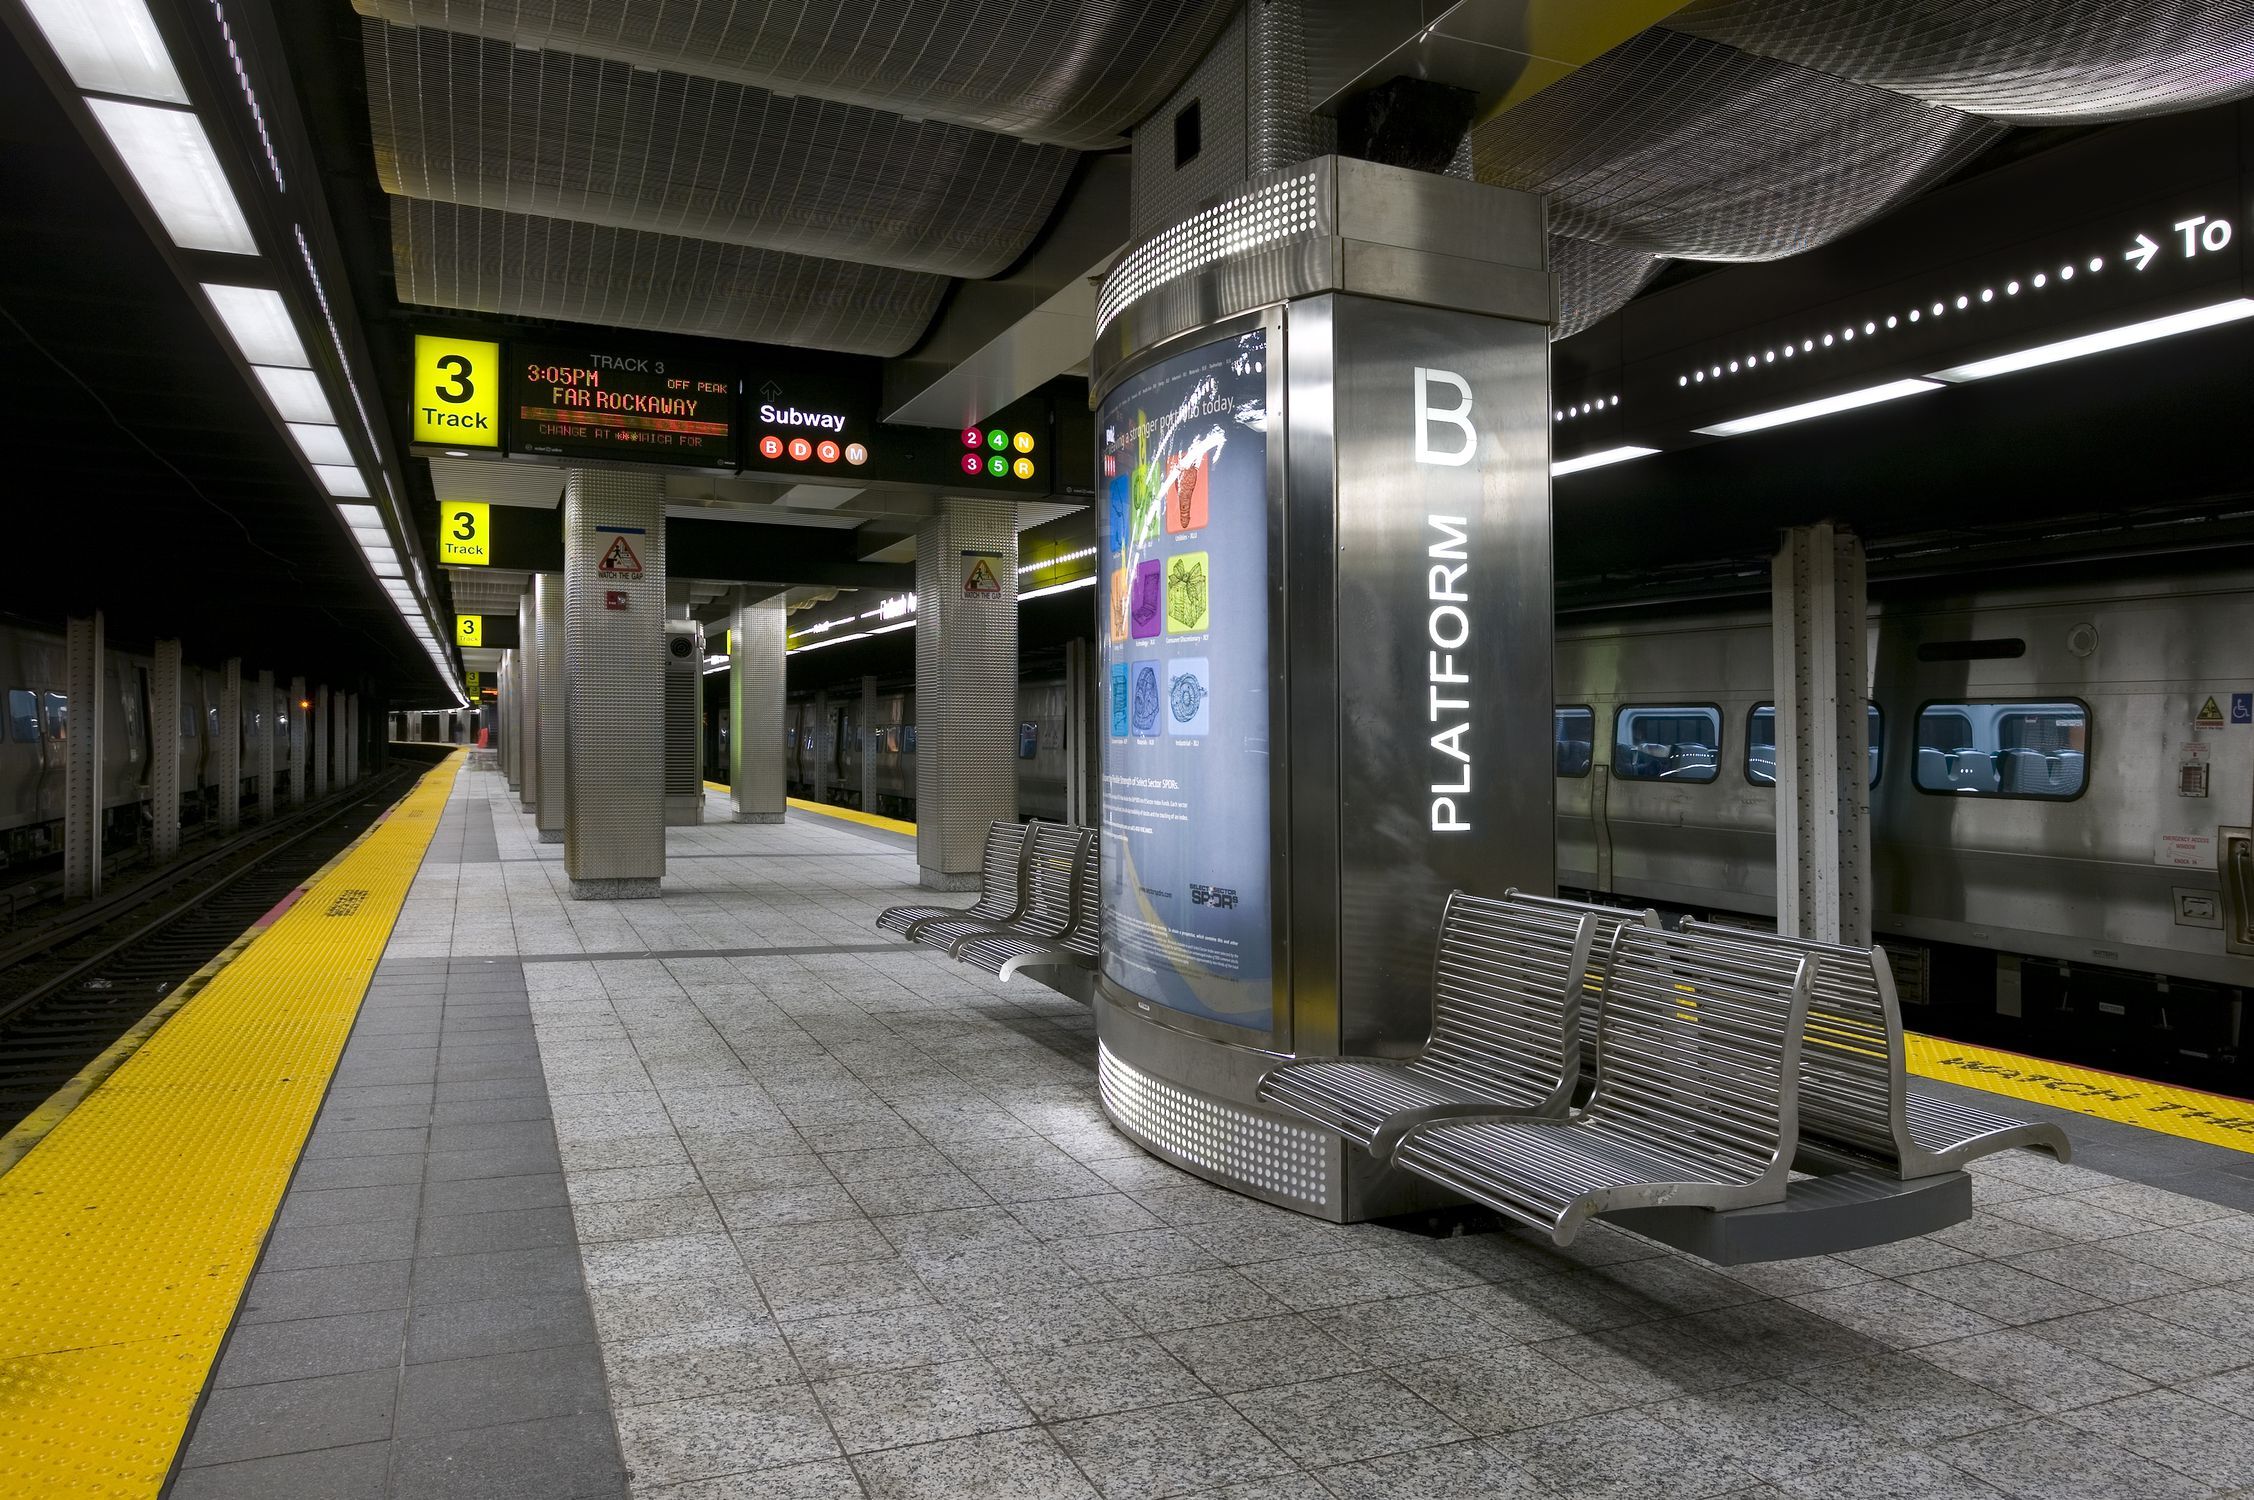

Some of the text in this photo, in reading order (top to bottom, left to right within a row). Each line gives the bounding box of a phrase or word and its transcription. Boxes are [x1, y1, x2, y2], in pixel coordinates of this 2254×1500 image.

[2174, 215, 2232, 258] To
[590, 354, 665, 374] TRACK 3
[435, 355, 475, 404] 3
[527, 364, 599, 387] 3:05PM
[667, 378, 728, 394] OFF PEAK
[552, 387, 698, 416] FAR ROCKAWAY
[422, 408, 488, 430] Track
[759, 404, 846, 432] Subway
[1130, 418, 1158, 441] stronger
[1202, 394, 1235, 415] today.
[1414, 366, 1478, 467] B
[539, 424, 587, 438] CHANGE
[594, 429, 610, 440] AT
[679, 435, 702, 447] FOR
[967, 432, 1029, 448] 2 4 N
[766, 441, 863, 460] B D Q M
[967, 458, 1028, 475] 3 5 R
[452, 511, 475, 540] 3
[445, 543, 483, 555] Track
[598, 571, 644, 580] WATCH THE GAP
[964, 591, 979, 599] WATCH
[991, 592, 1001, 600] GAP
[463, 620, 474, 634] 3
[469, 672, 476, 680] 3
[1428, 514, 1471, 831] PLATFORM
[1189, 883, 1209, 892] SELECT
